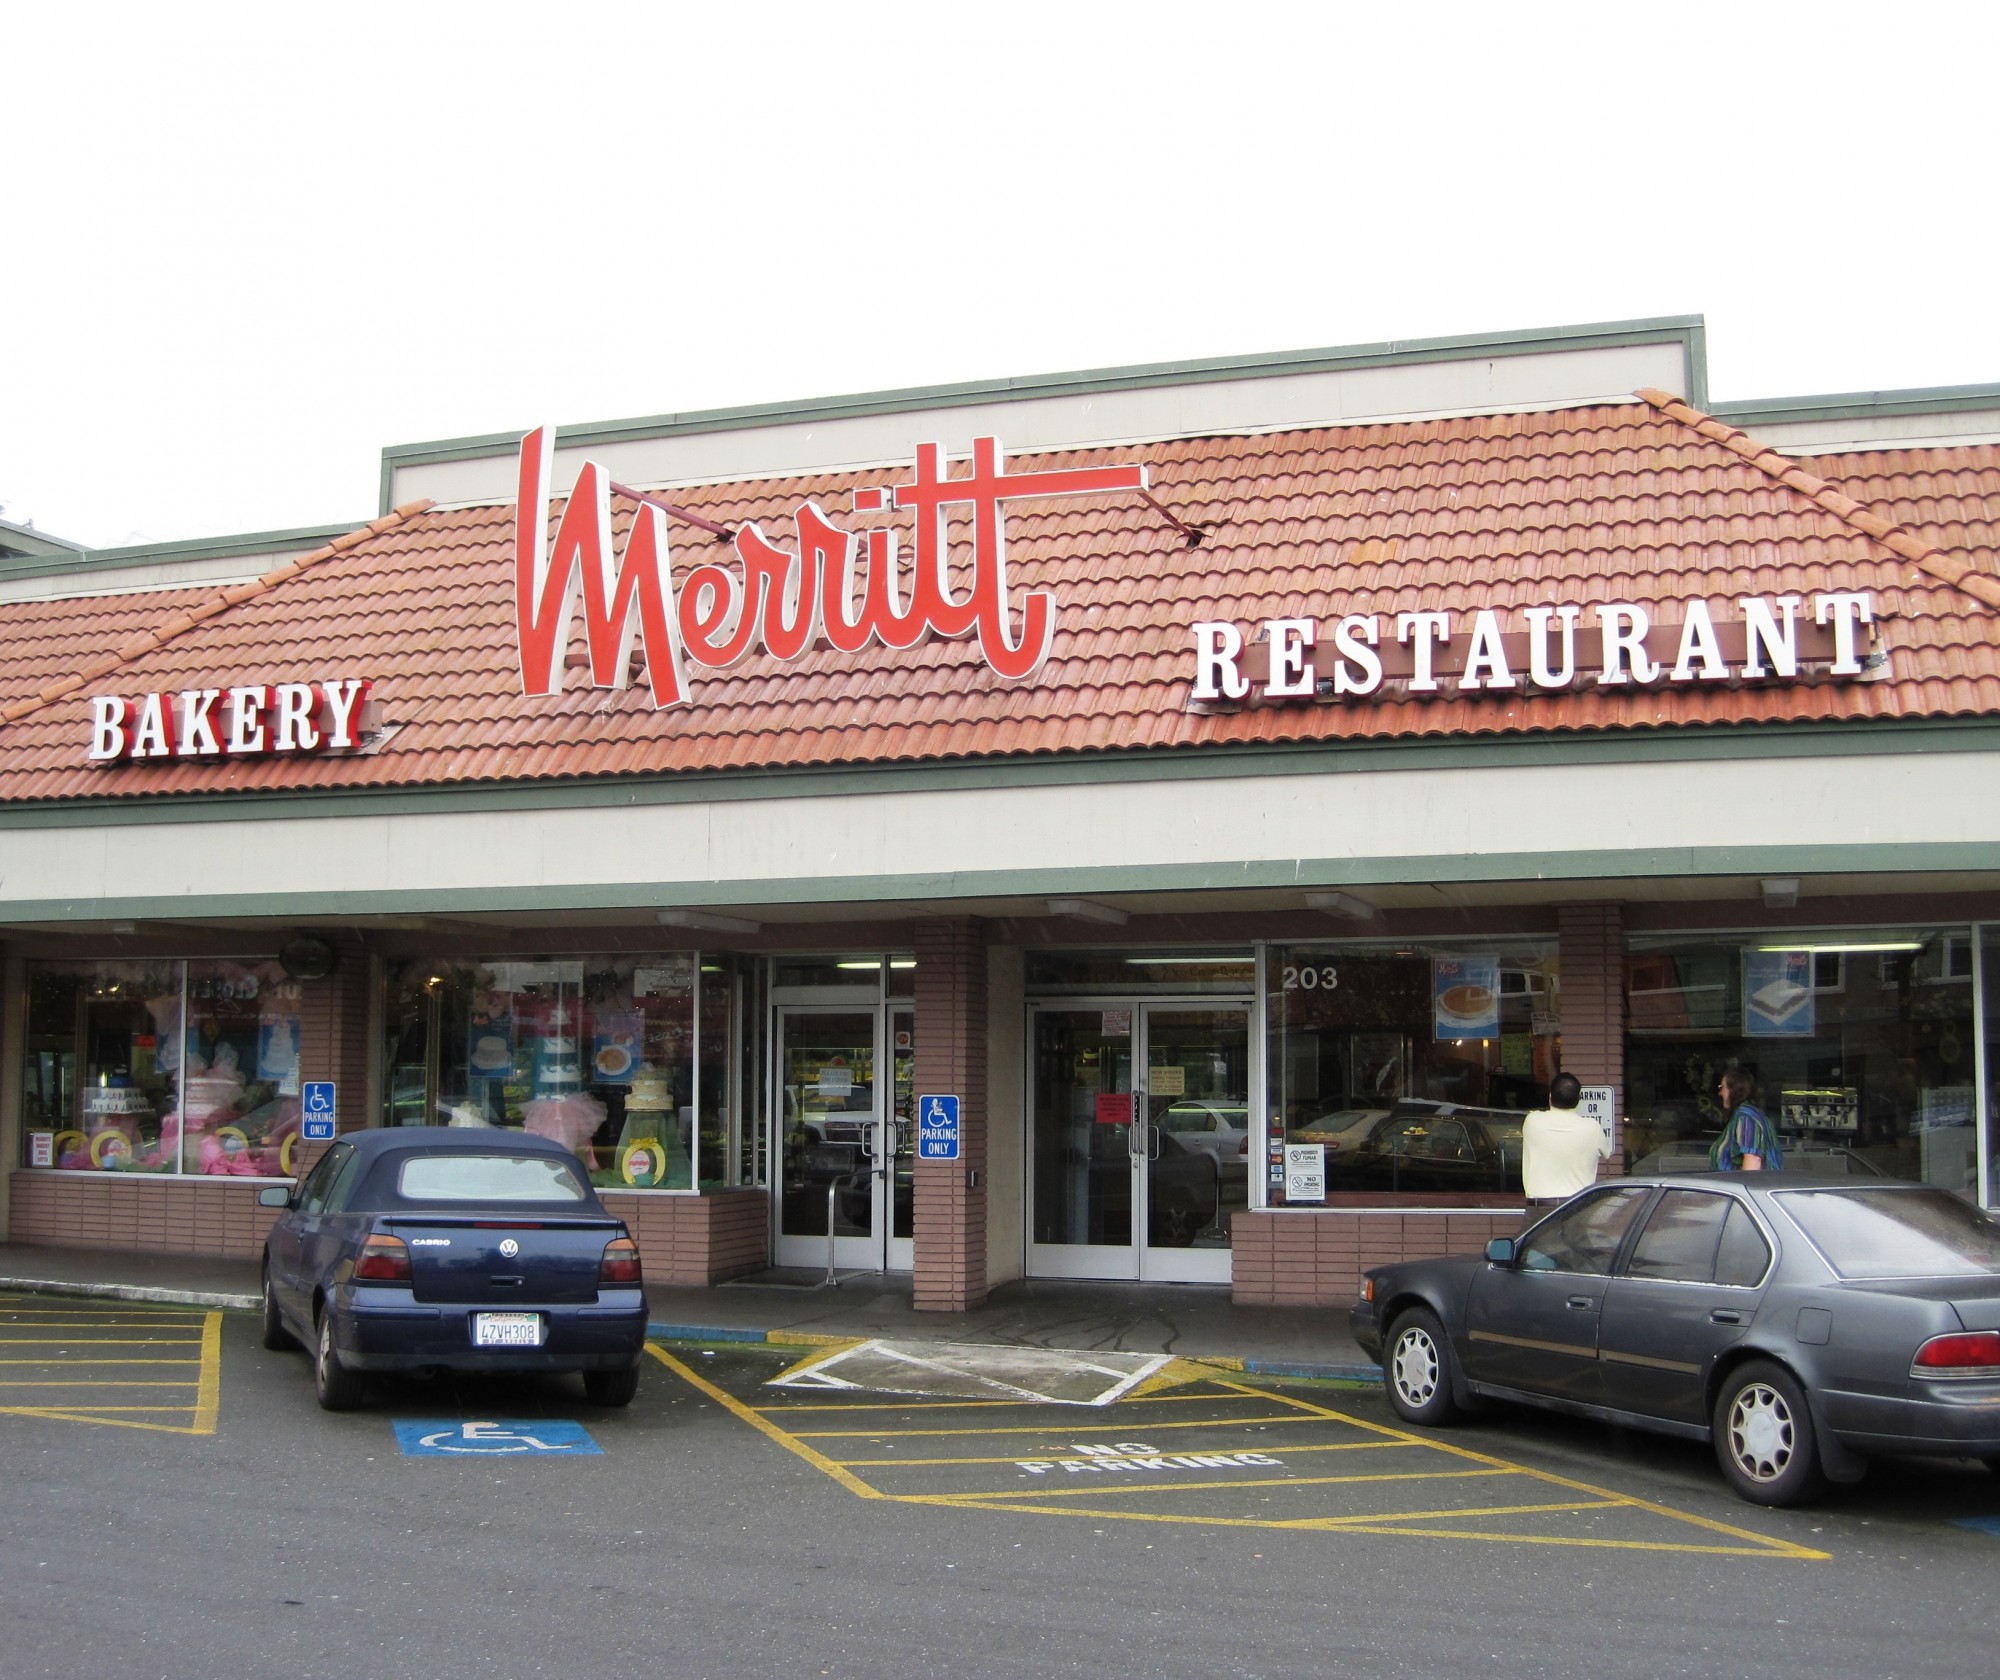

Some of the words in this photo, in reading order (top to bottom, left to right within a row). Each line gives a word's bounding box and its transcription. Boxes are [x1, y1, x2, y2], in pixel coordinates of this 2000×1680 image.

[515, 425, 1149, 711] Merritt
[1192, 593, 1871, 700] RESTAURANT
[89, 680, 372, 760] BAKERY
[1282, 966, 1338, 990] 203
[1580, 1091, 1606, 1101] ARKING
[1588, 1103, 1598, 1113] OR
[305, 1111, 333, 1123] PARKING
[310, 1124, 327, 1136] ONLY
[921, 1128, 957, 1140] PARKING
[928, 1142, 950, 1155] ONLY
[481, 1324, 535, 1339] 4ZVH308
[1070, 1442, 1160, 1456] NO
[1015, 1453, 1284, 1474] PARKING
